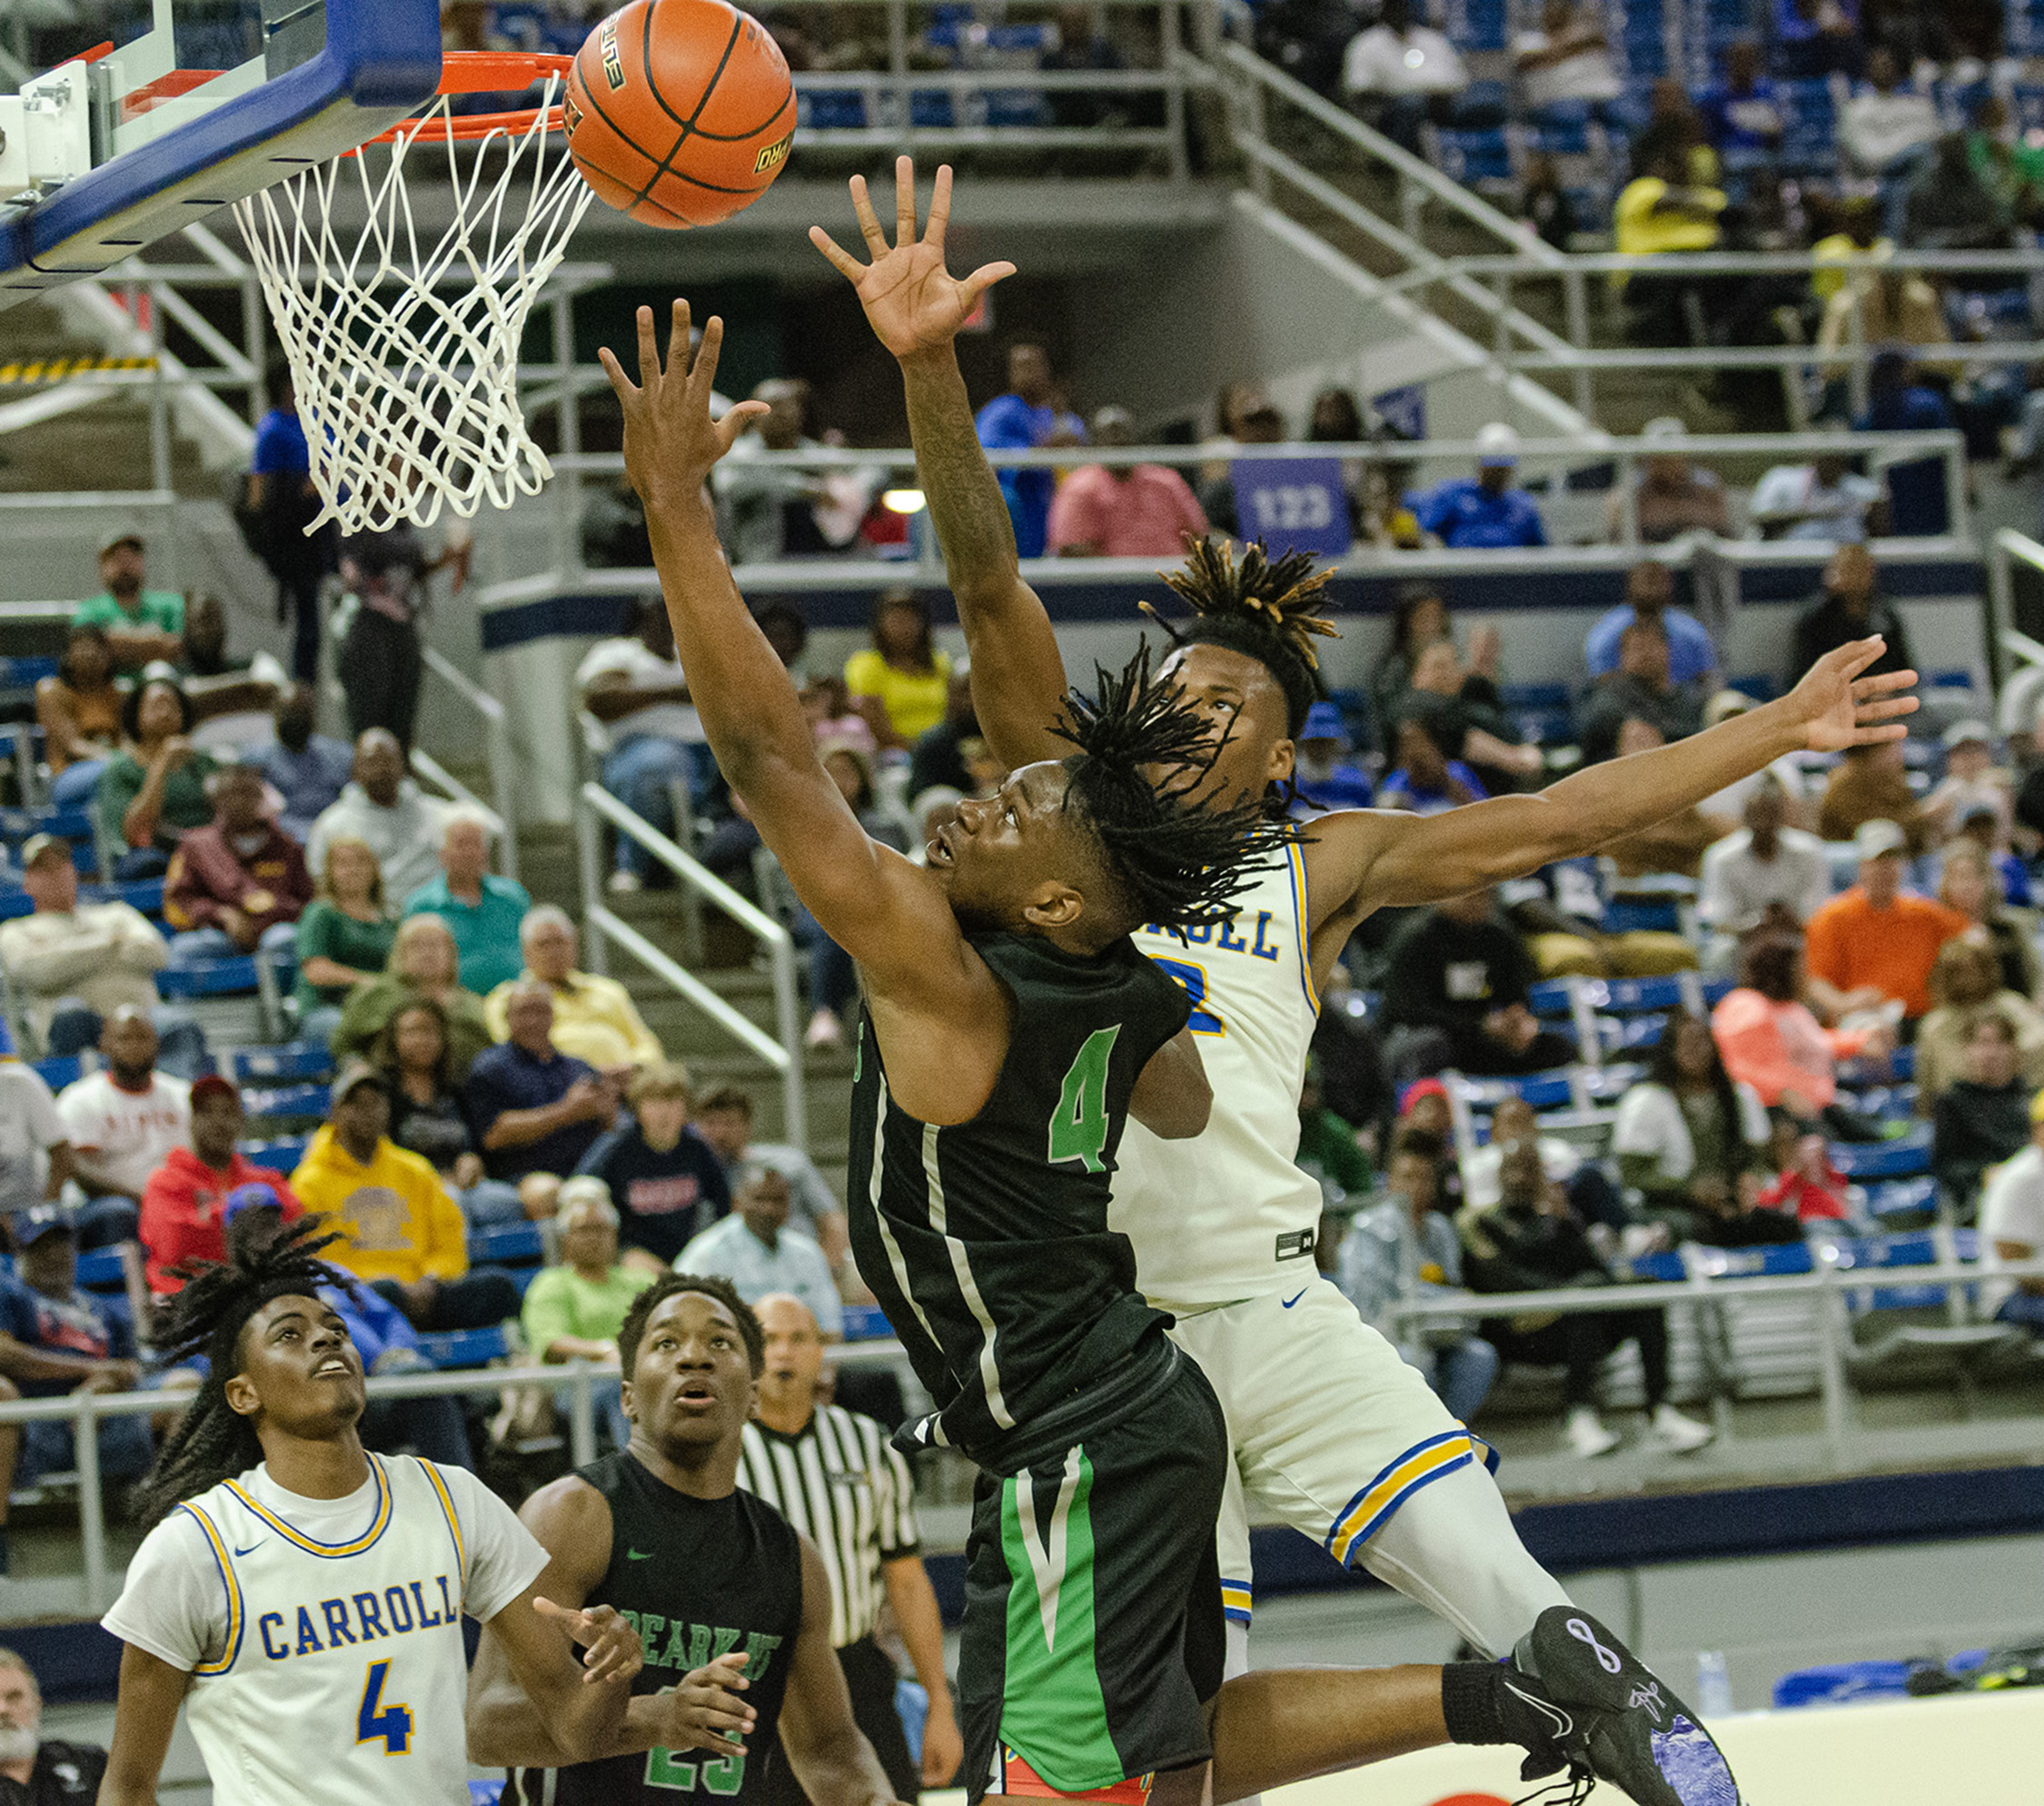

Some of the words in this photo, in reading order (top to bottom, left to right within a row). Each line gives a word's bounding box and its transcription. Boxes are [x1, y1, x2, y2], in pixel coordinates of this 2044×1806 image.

[758, 141, 789, 171] PRO
[1048, 1023, 1122, 1174] 4
[258, 1574, 458, 1661] CARROLL
[355, 1657, 415, 1757] 4
